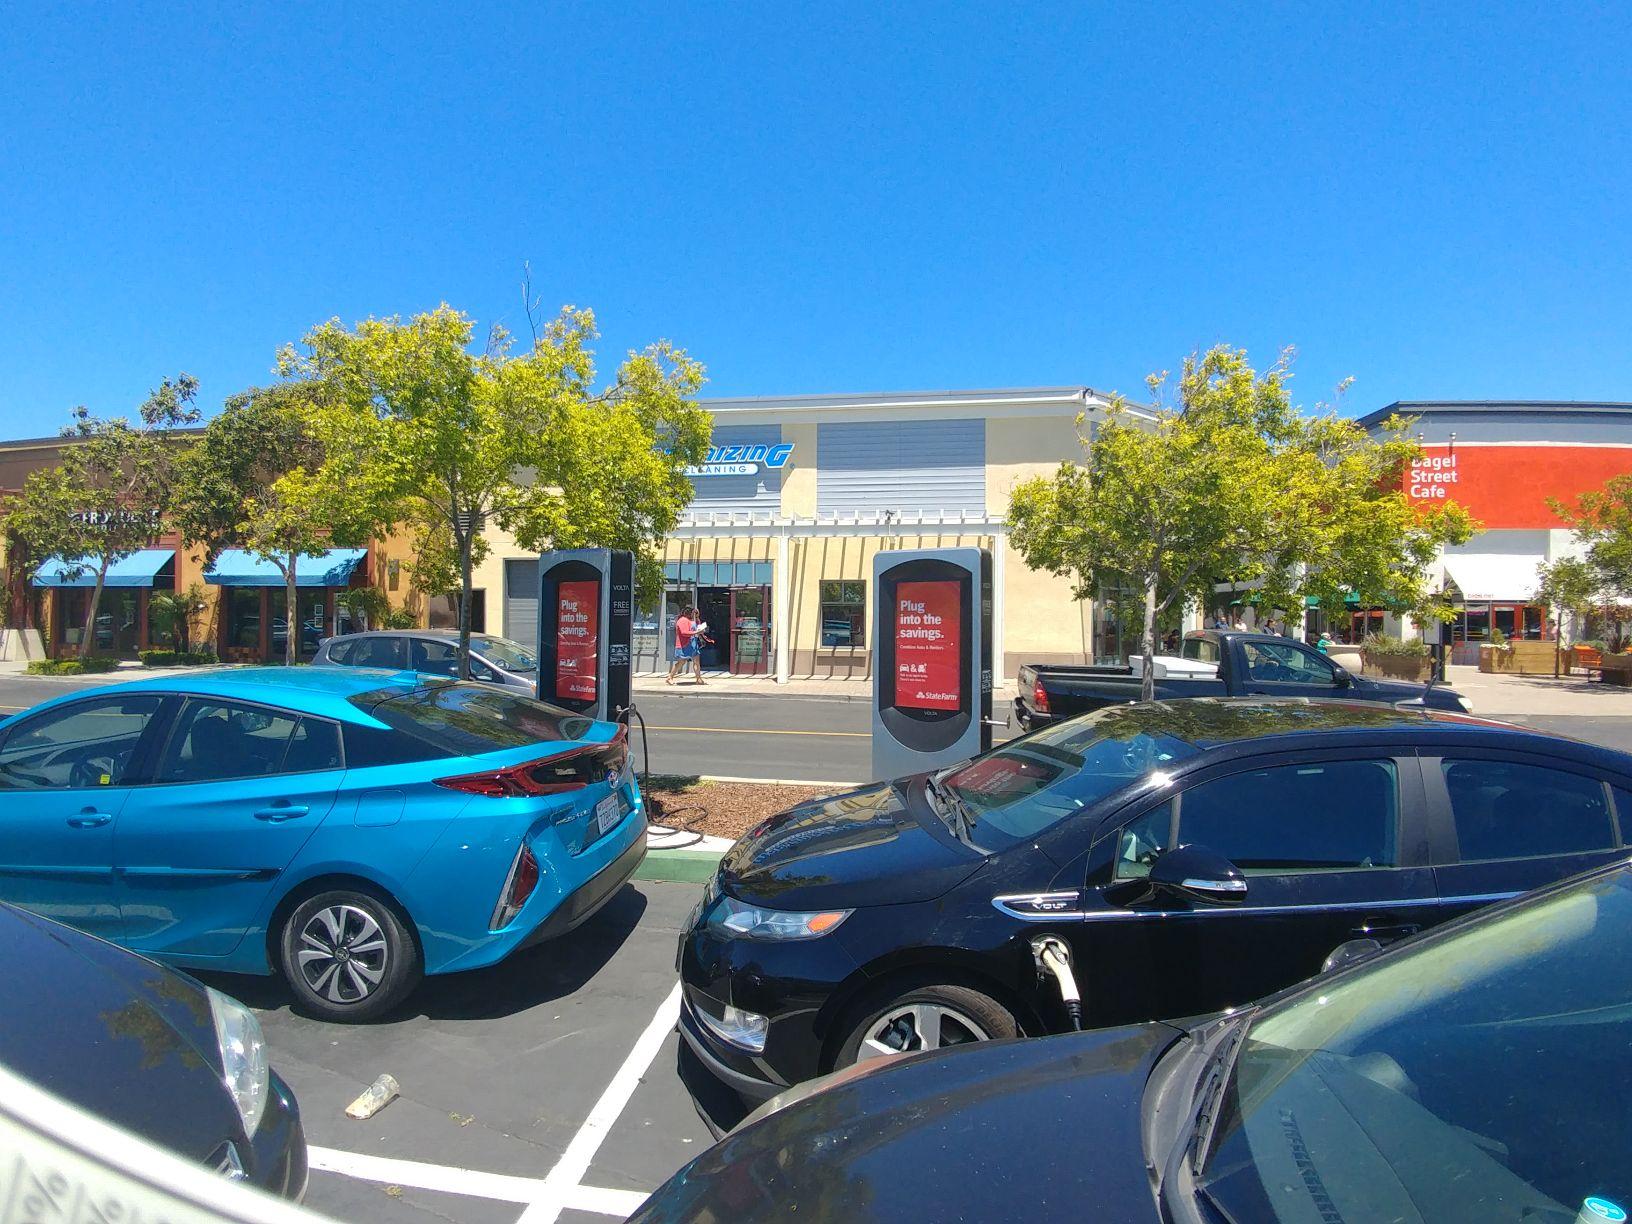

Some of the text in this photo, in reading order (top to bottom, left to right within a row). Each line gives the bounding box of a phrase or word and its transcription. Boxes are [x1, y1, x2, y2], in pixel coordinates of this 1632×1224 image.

[1411, 454, 1456, 470] Bagel
[1411, 470, 1458, 483] Street
[1411, 485, 1445, 498] Cafe
[561, 600, 578, 613] Plug
[613, 601, 630, 609] FREE
[900, 600, 925, 613] Plug
[561, 612, 588, 622] into the
[900, 614, 942, 625] into the
[900, 627, 944, 640] savings.
[1032, 902, 1067, 910] VOLT
